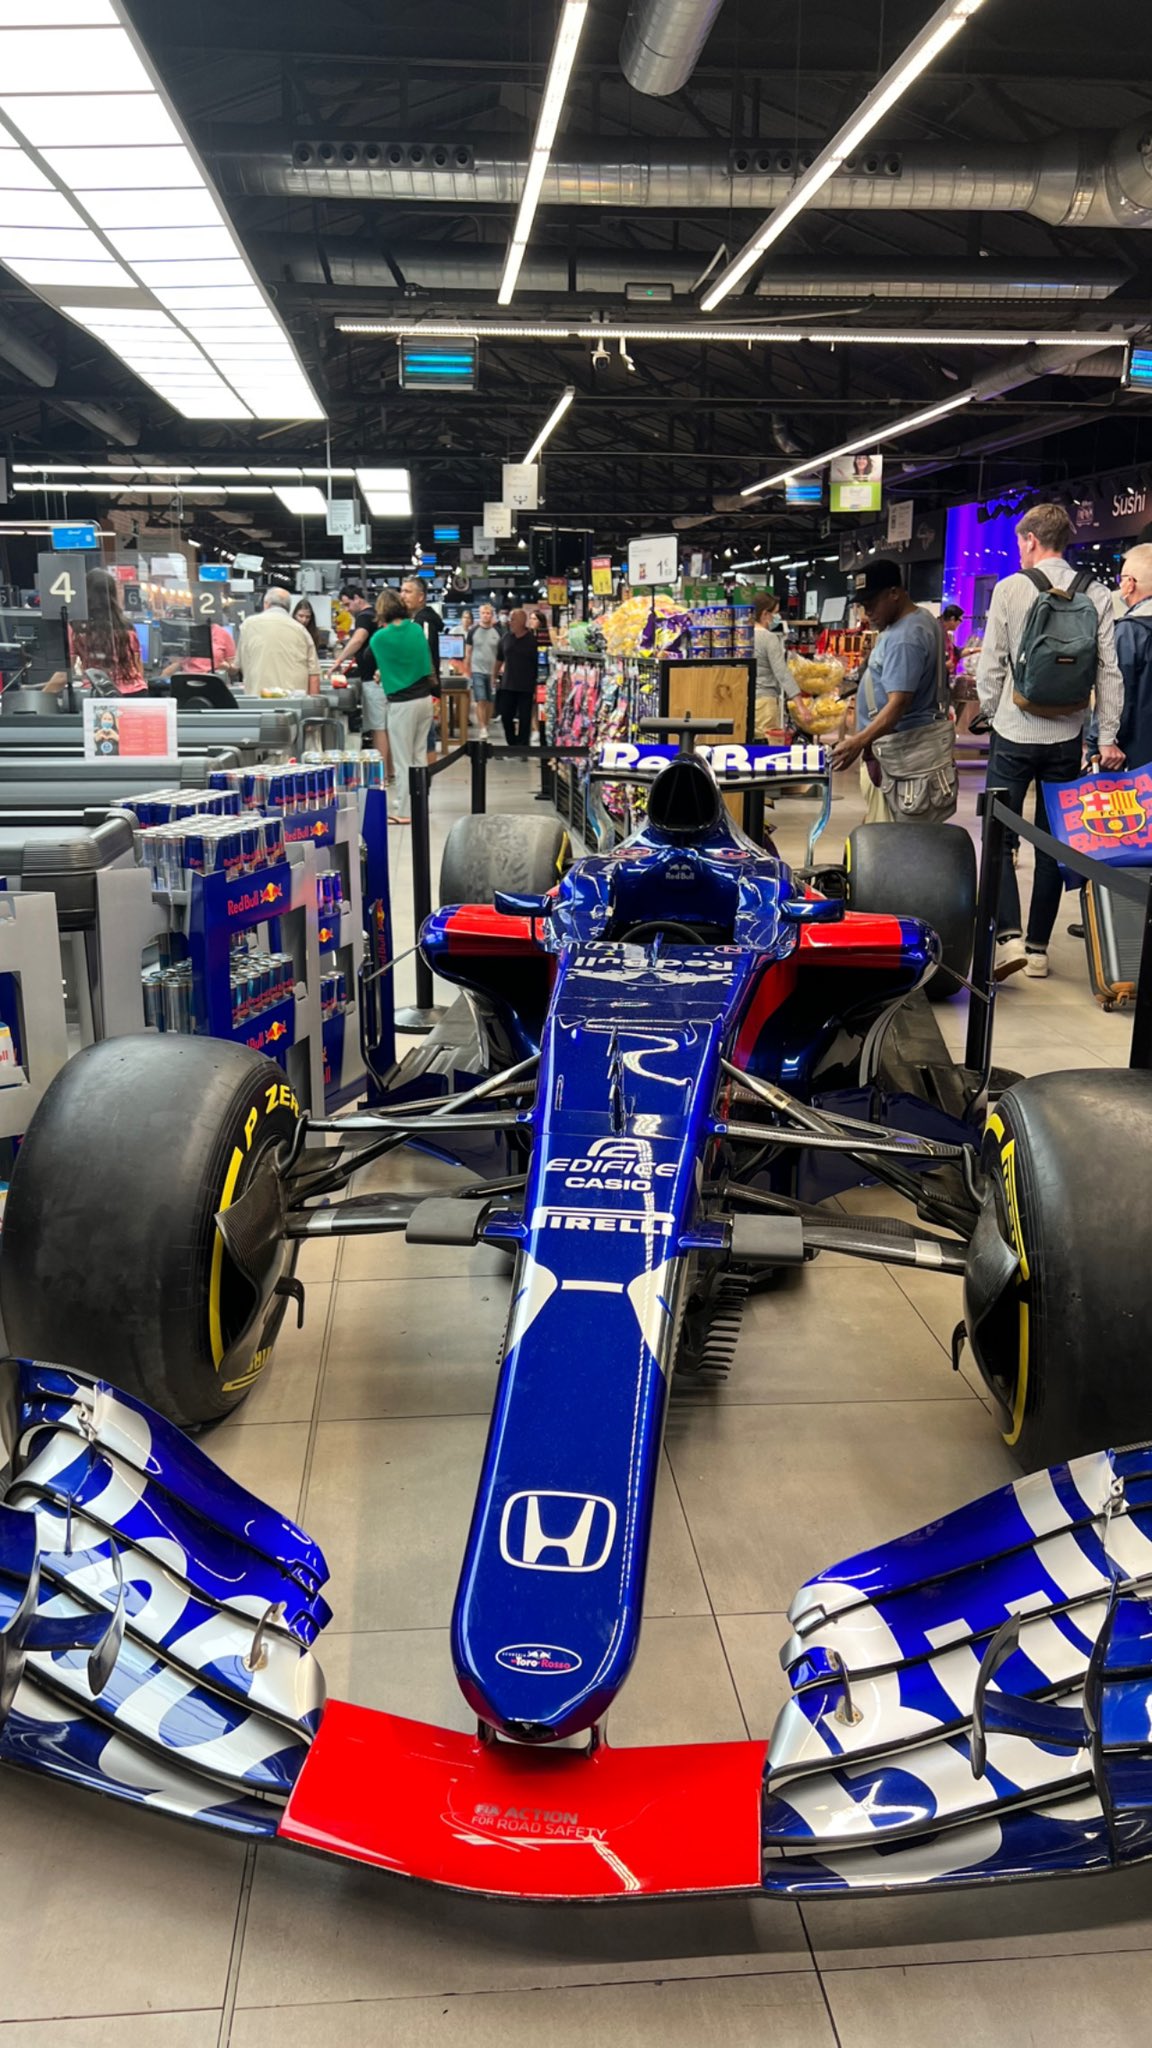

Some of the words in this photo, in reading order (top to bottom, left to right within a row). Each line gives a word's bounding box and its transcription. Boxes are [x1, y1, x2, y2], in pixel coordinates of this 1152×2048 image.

[1112, 487, 1147, 517] Sushi
[49, 571, 77, 604] 4
[128, 590, 139, 605] 6
[199, 592, 216, 615] 2
[665, 872, 680, 880] Red
[681, 872, 695, 880] Bull
[227, 893, 245, 916] Red
[244, 890, 259, 911] Bull
[574, 956, 649, 968] Bull
[655, 957, 733, 971] Red
[244, 1106, 258, 1152] P
[544, 1158, 679, 1178] EDIFICE
[564, 1176, 652, 1192] CASIO
[530, 1206, 675, 1237] PIRELLI
[515, 1655, 538, 1668] Toro
[541, 1658, 571, 1670] Rosso
[474, 1803, 500, 1816] FIA
[503, 1807, 578, 1825] ACTION
[471, 1816, 496, 1826] FOR
[496, 1819, 541, 1833] ROAD
[545, 1825, 608, 1841] SAFETY
